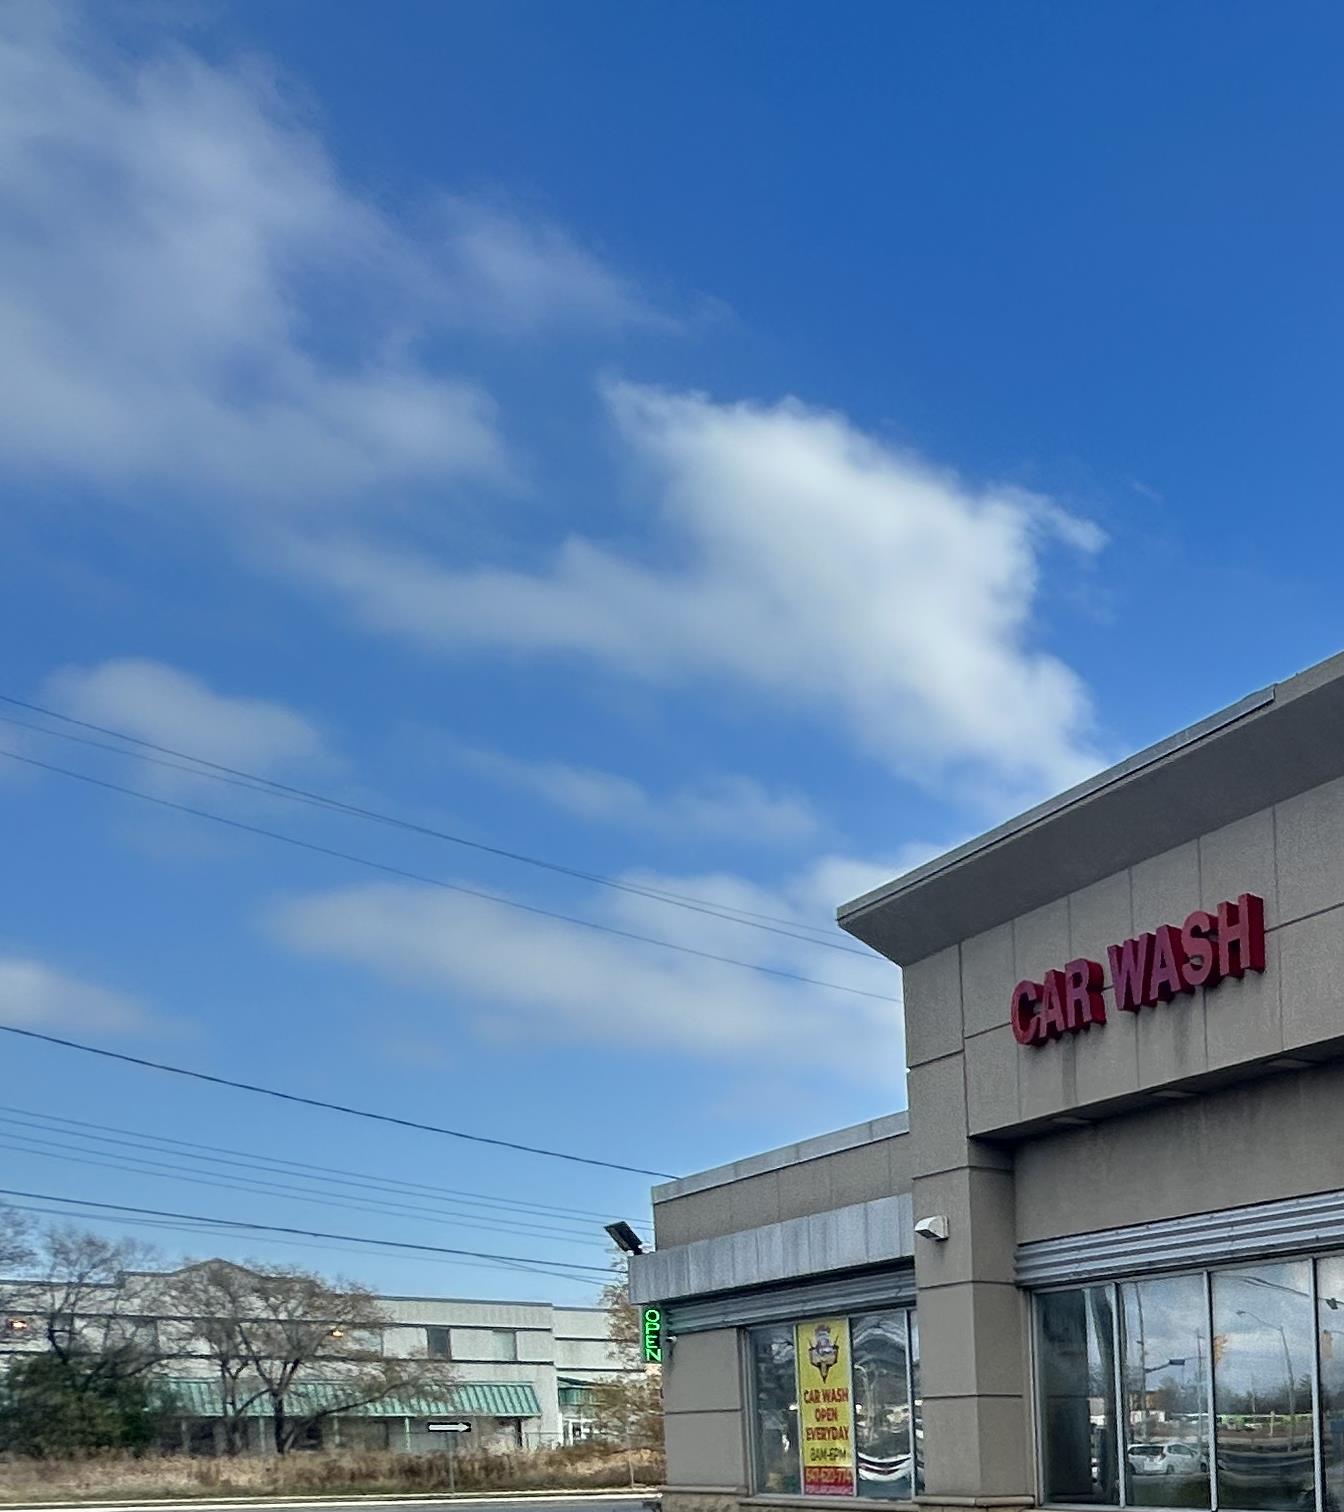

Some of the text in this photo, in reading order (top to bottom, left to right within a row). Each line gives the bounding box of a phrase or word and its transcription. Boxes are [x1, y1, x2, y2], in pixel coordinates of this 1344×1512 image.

[1010, 892, 1266, 1047] CAR WASH
[645, 1309, 662, 1362] OPEN
[804, 1387, 849, 1404] CAR WASH
[815, 1407, 838, 1422] OPEN
[806, 1426, 849, 1442] EVERYDAY
